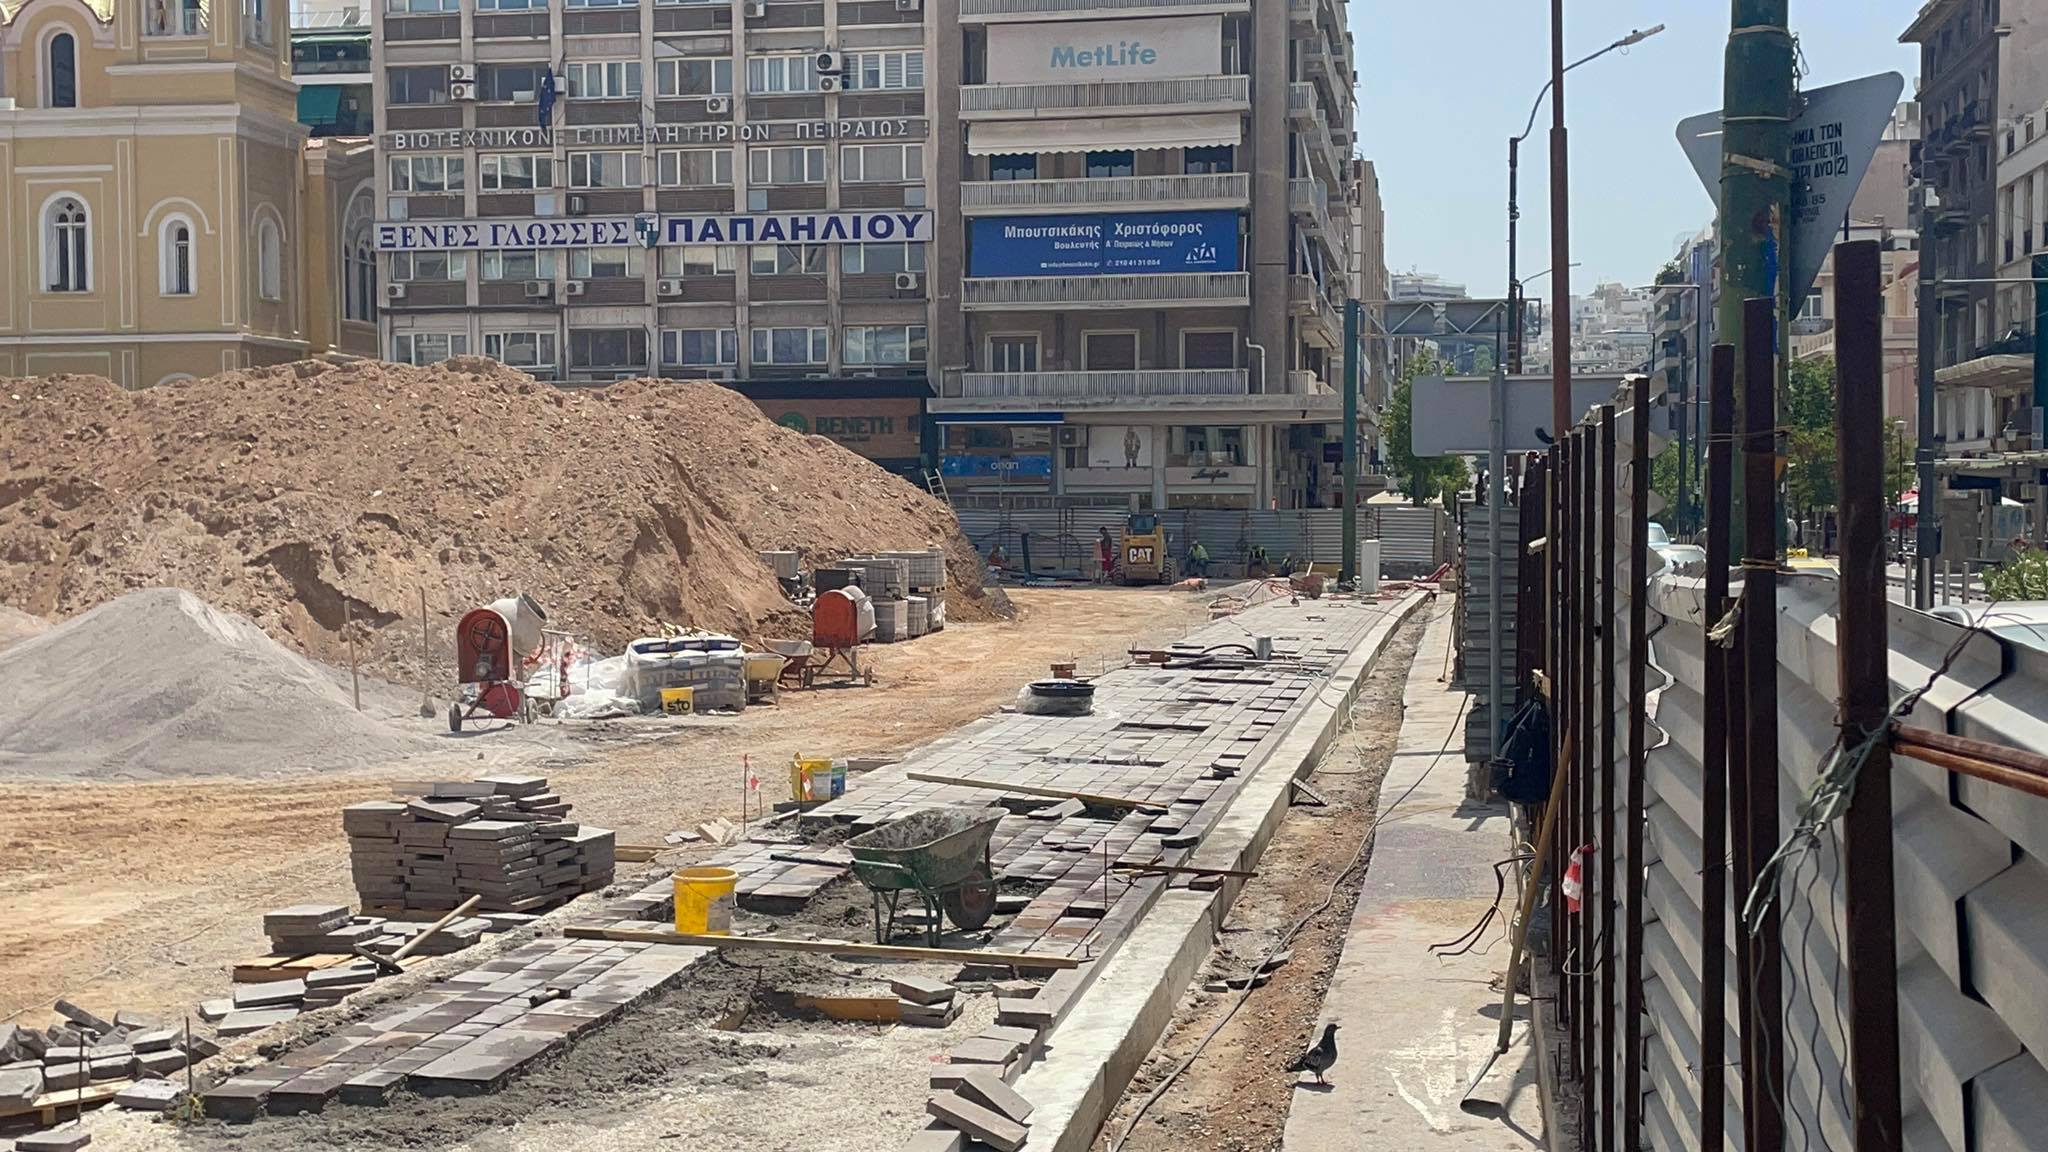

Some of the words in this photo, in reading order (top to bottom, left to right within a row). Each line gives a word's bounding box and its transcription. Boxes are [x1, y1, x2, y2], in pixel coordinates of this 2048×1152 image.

[1050, 41, 1157, 68] MetLife
[395, 129, 550, 149] ΒΙΟΤΕΧΝΙΚΟΝ
[576, 124, 769, 144] ΕΠΙΜΕΛΗΤΗΡΙΟΝ
[796, 120, 908, 139] ΠΕΙΡΑΙΩΣ
[1820, 122, 1842, 140] ΤΩΝ
[1814, 160, 1833, 178] ΔΥΟ
[380, 225, 479, 248] ΞΕΝΕΣ
[490, 221, 629, 246] ΓΛΩΣΣΕΣ
[668, 214, 923, 243] ΠΑΠΑΗΛΙΟΥ
[1004, 224, 1102, 238] Μπουτσικάκης
[1114, 222, 1203, 237] Χριστόφορος
[1054, 240, 1100, 250] Βουλευτής
[1129, 548, 1153, 563] CAT
[667, 698, 690, 712] sto
